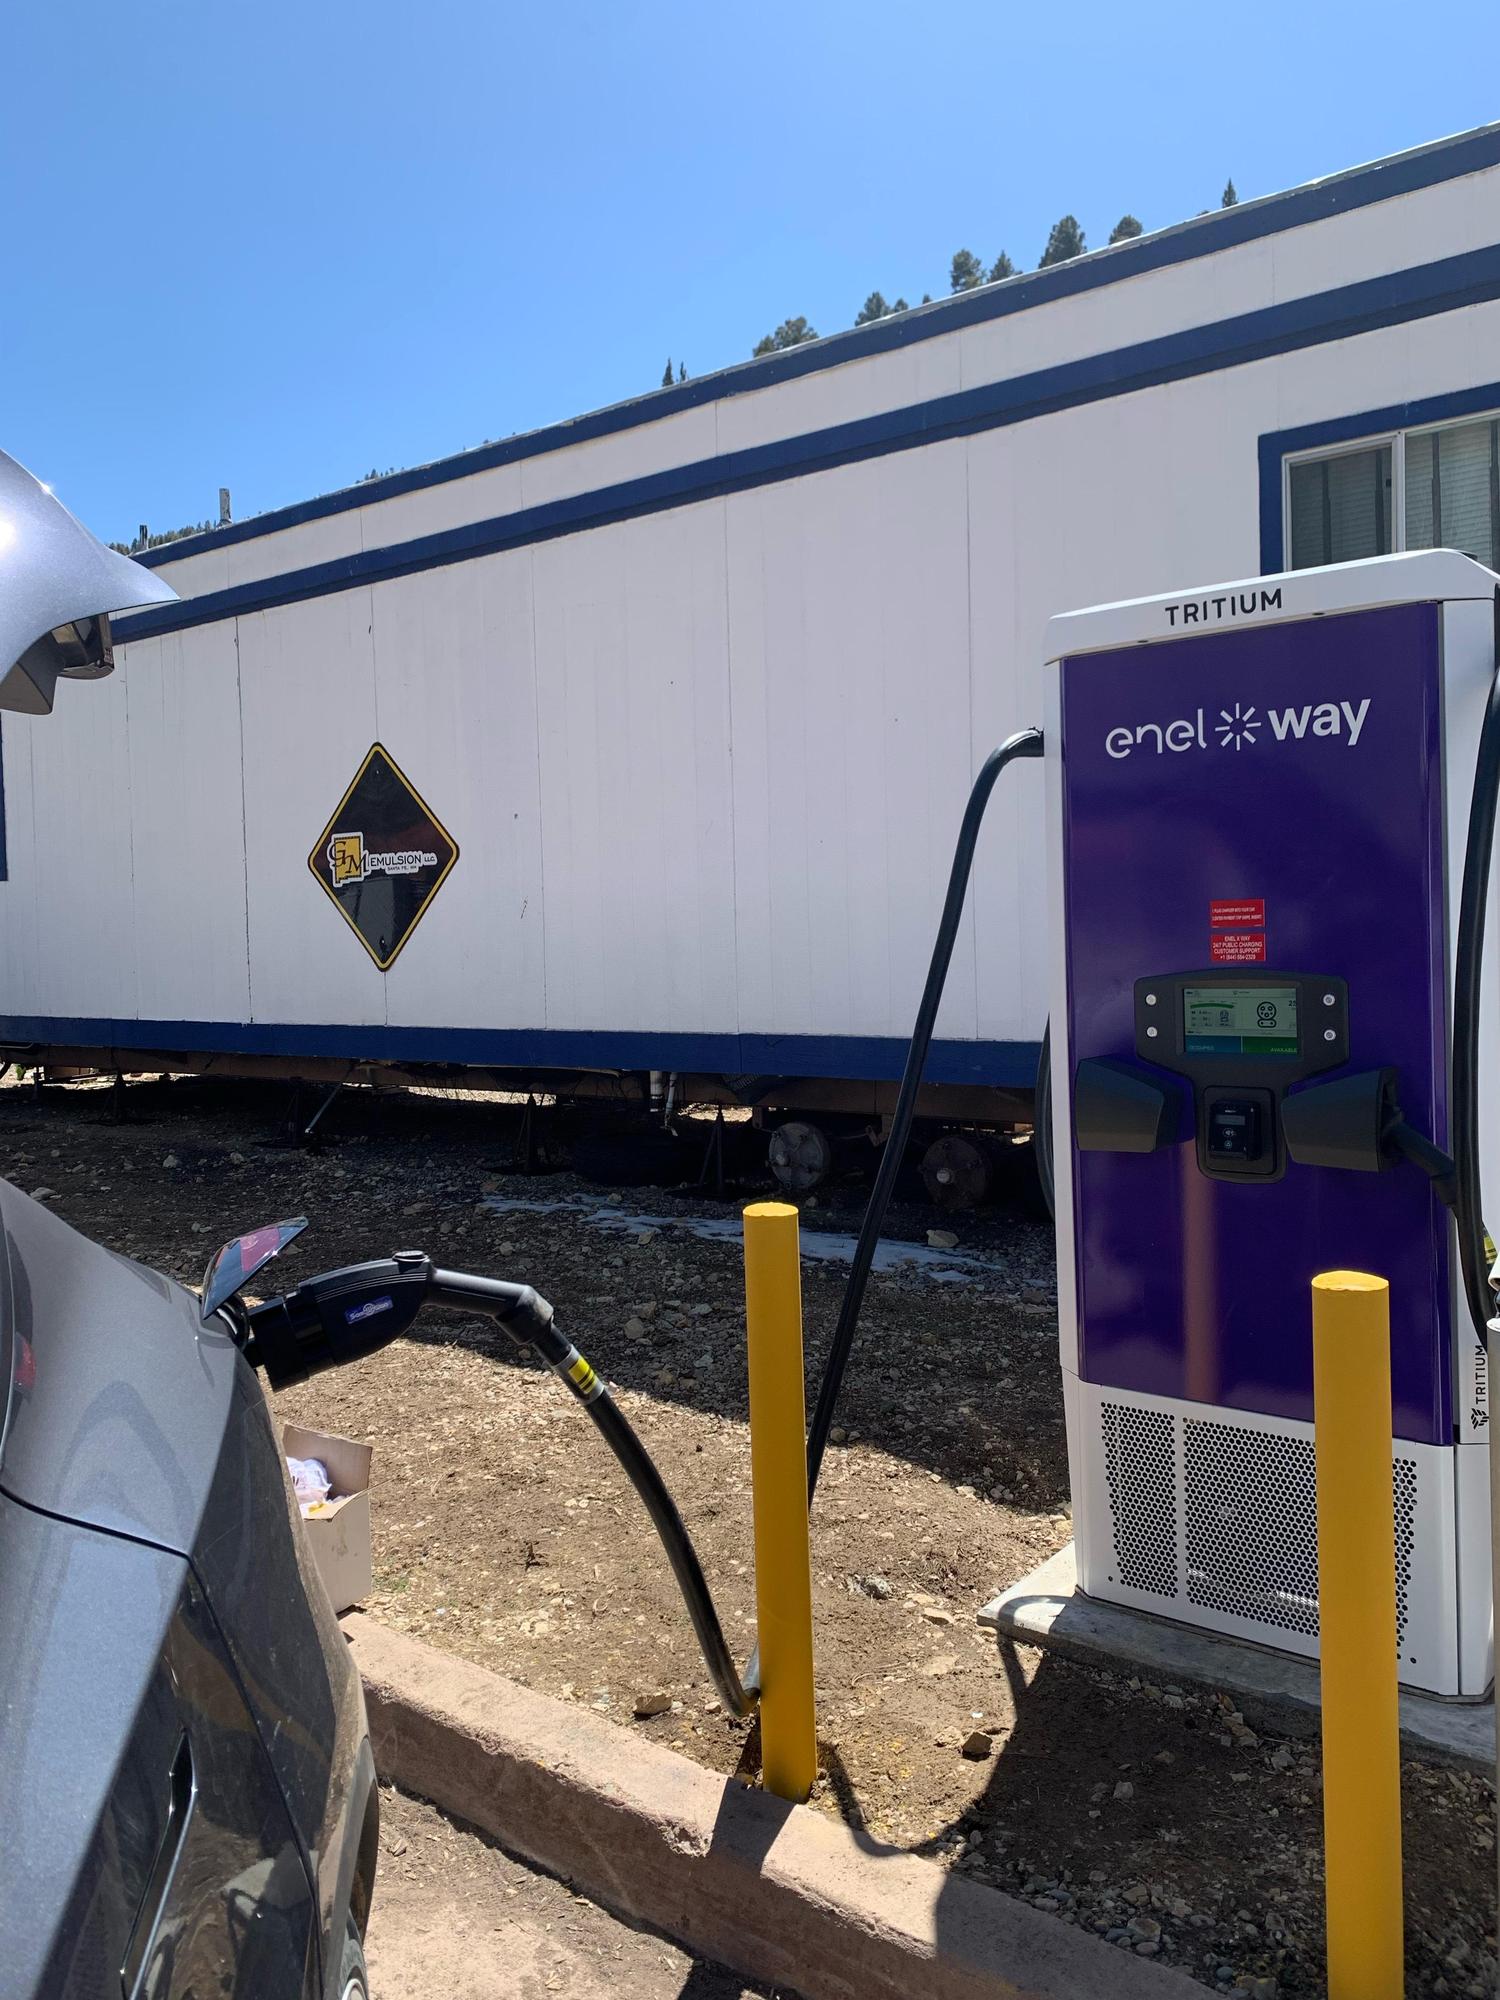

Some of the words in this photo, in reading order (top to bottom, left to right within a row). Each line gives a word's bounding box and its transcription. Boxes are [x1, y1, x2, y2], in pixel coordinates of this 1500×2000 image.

[1165, 588, 1283, 626] TRITIUM
[1105, 707, 1208, 759] enel
[1268, 698, 1372, 746] way
[371, 854, 421, 866] EMULSION
[1475, 1345, 1486, 1405] TRITIUM
